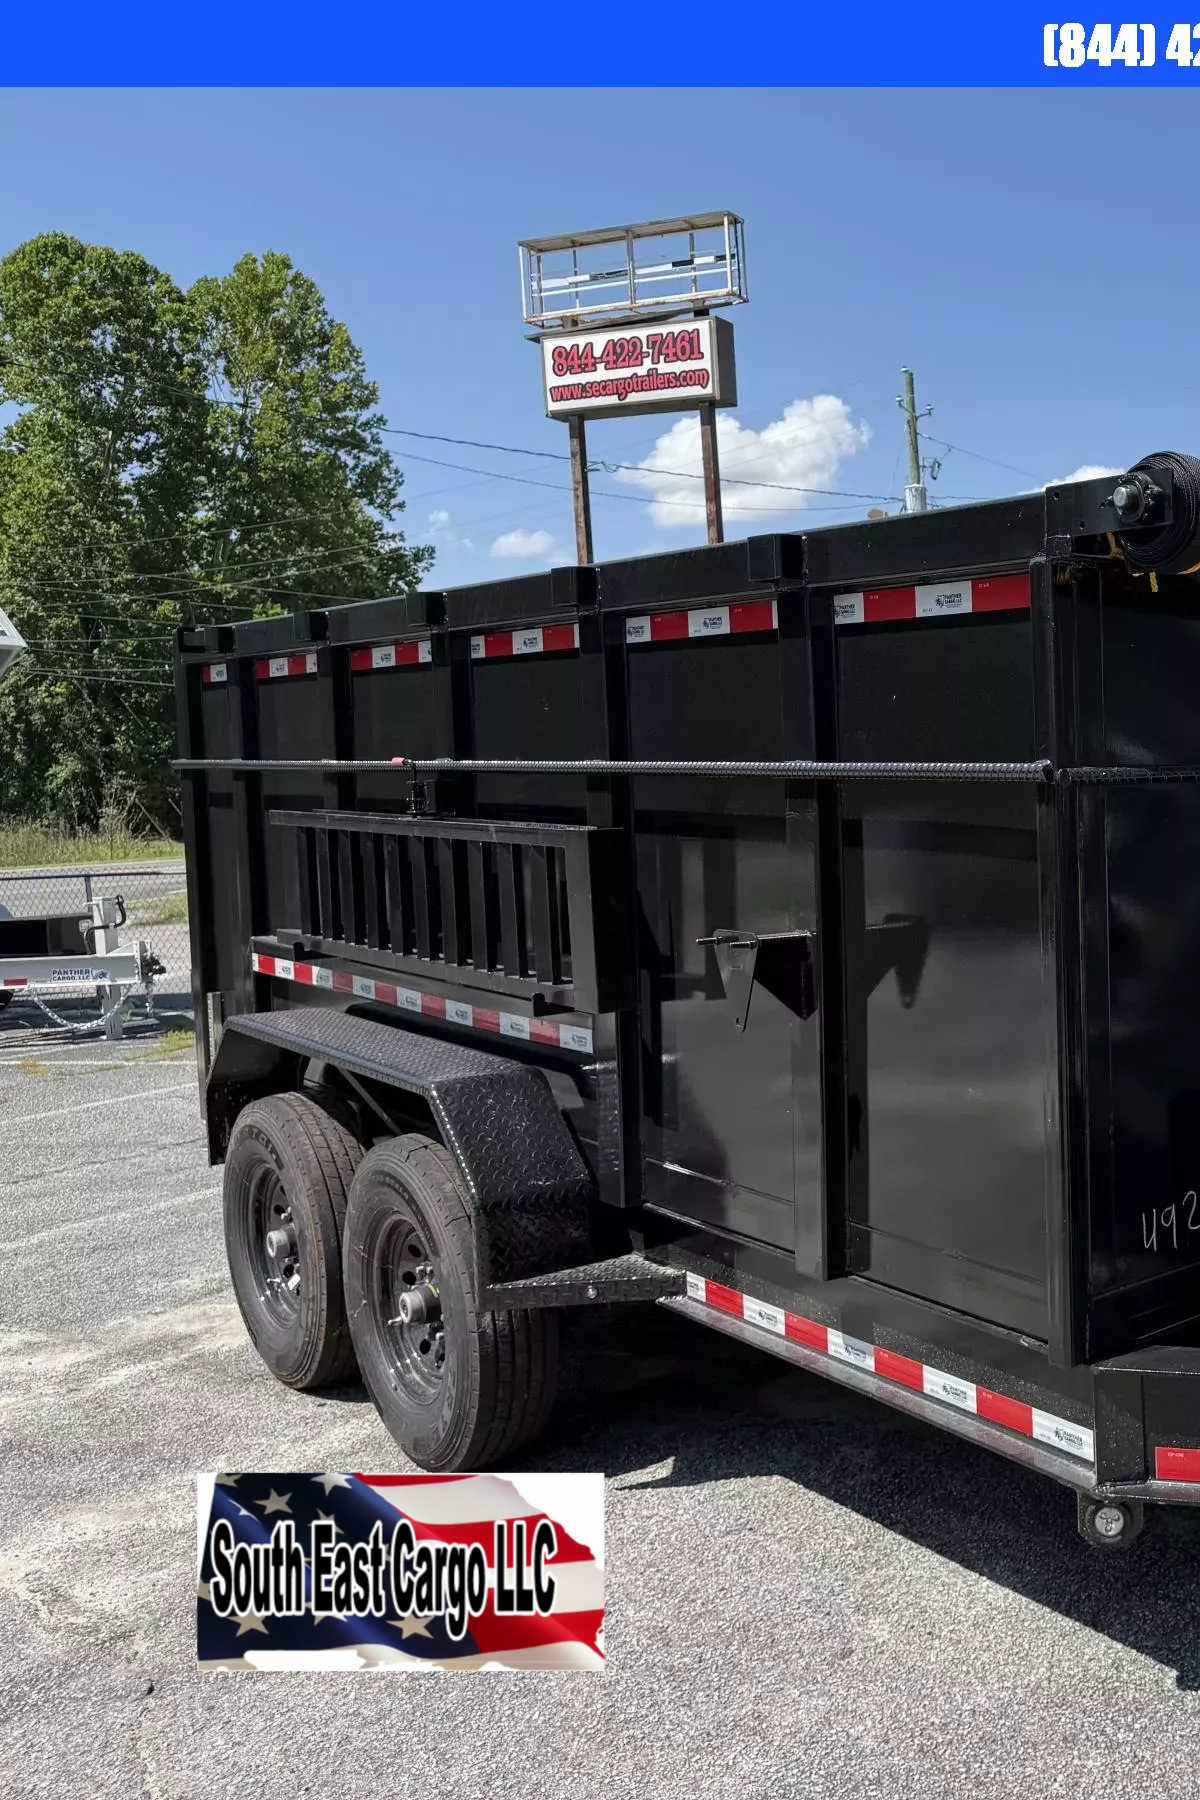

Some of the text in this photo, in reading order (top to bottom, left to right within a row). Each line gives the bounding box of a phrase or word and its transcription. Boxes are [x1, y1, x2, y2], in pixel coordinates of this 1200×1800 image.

[552, 328, 704, 377] 844-422-7461
[550, 368, 709, 401] www.secargotrailers.com
[52, 969, 91, 977] PANTHER
